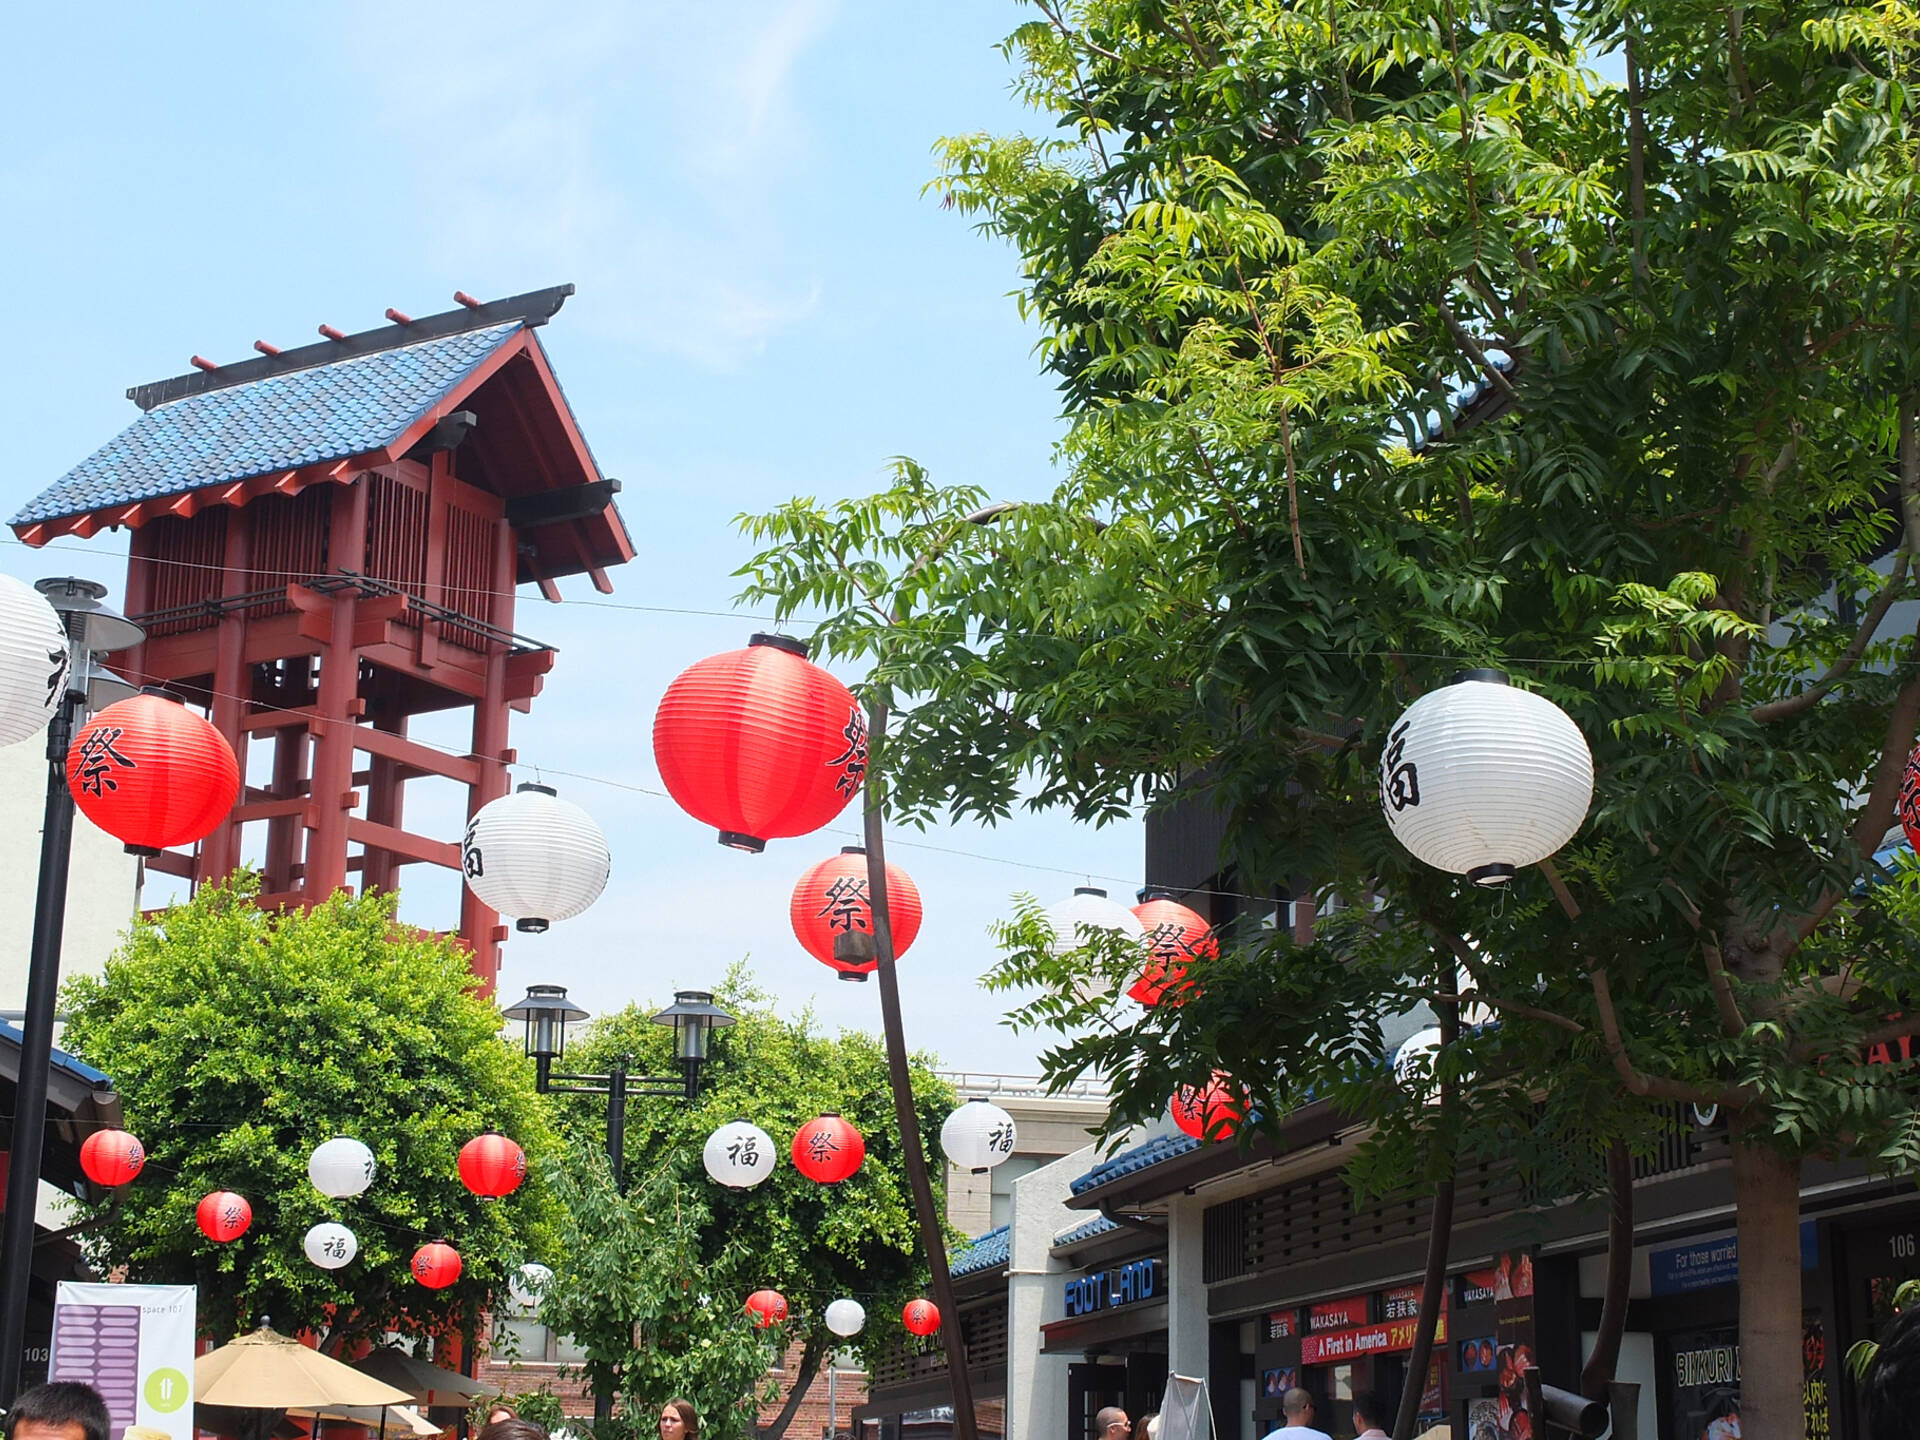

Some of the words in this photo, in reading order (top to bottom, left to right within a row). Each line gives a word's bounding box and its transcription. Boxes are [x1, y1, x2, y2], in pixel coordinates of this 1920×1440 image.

[72, 727, 136, 798] 祭
[816, 877, 872, 931] 祭
[808, 1132, 839, 1162] 祭
[988, 1121, 1013, 1153] 福
[727, 1136, 759, 1167] 福
[222, 1207, 245, 1229] 祭
[323, 1236, 347, 1259] 福
[1675, 1253, 1688, 1269] For
[1689, 1250, 1710, 1266] those
[1711, 1242, 1737, 1263] worried
[1889, 1233, 1915, 1258] 106
[416, 1256, 433, 1276] 祭
[1064, 1273, 1104, 1317] FOOT
[1109, 1259, 1155, 1307] LAND
[1464, 1287, 1494, 1302] WAKASAYA
[1310, 1311, 1349, 1331] WAKASAYA
[24, 1347, 49, 1361] 103
[1318, 1339, 1325, 1357] A
[1326, 1336, 1345, 1356] First
[1345, 1335, 1353, 1353] in
[1354, 1329, 1388, 1351] America
